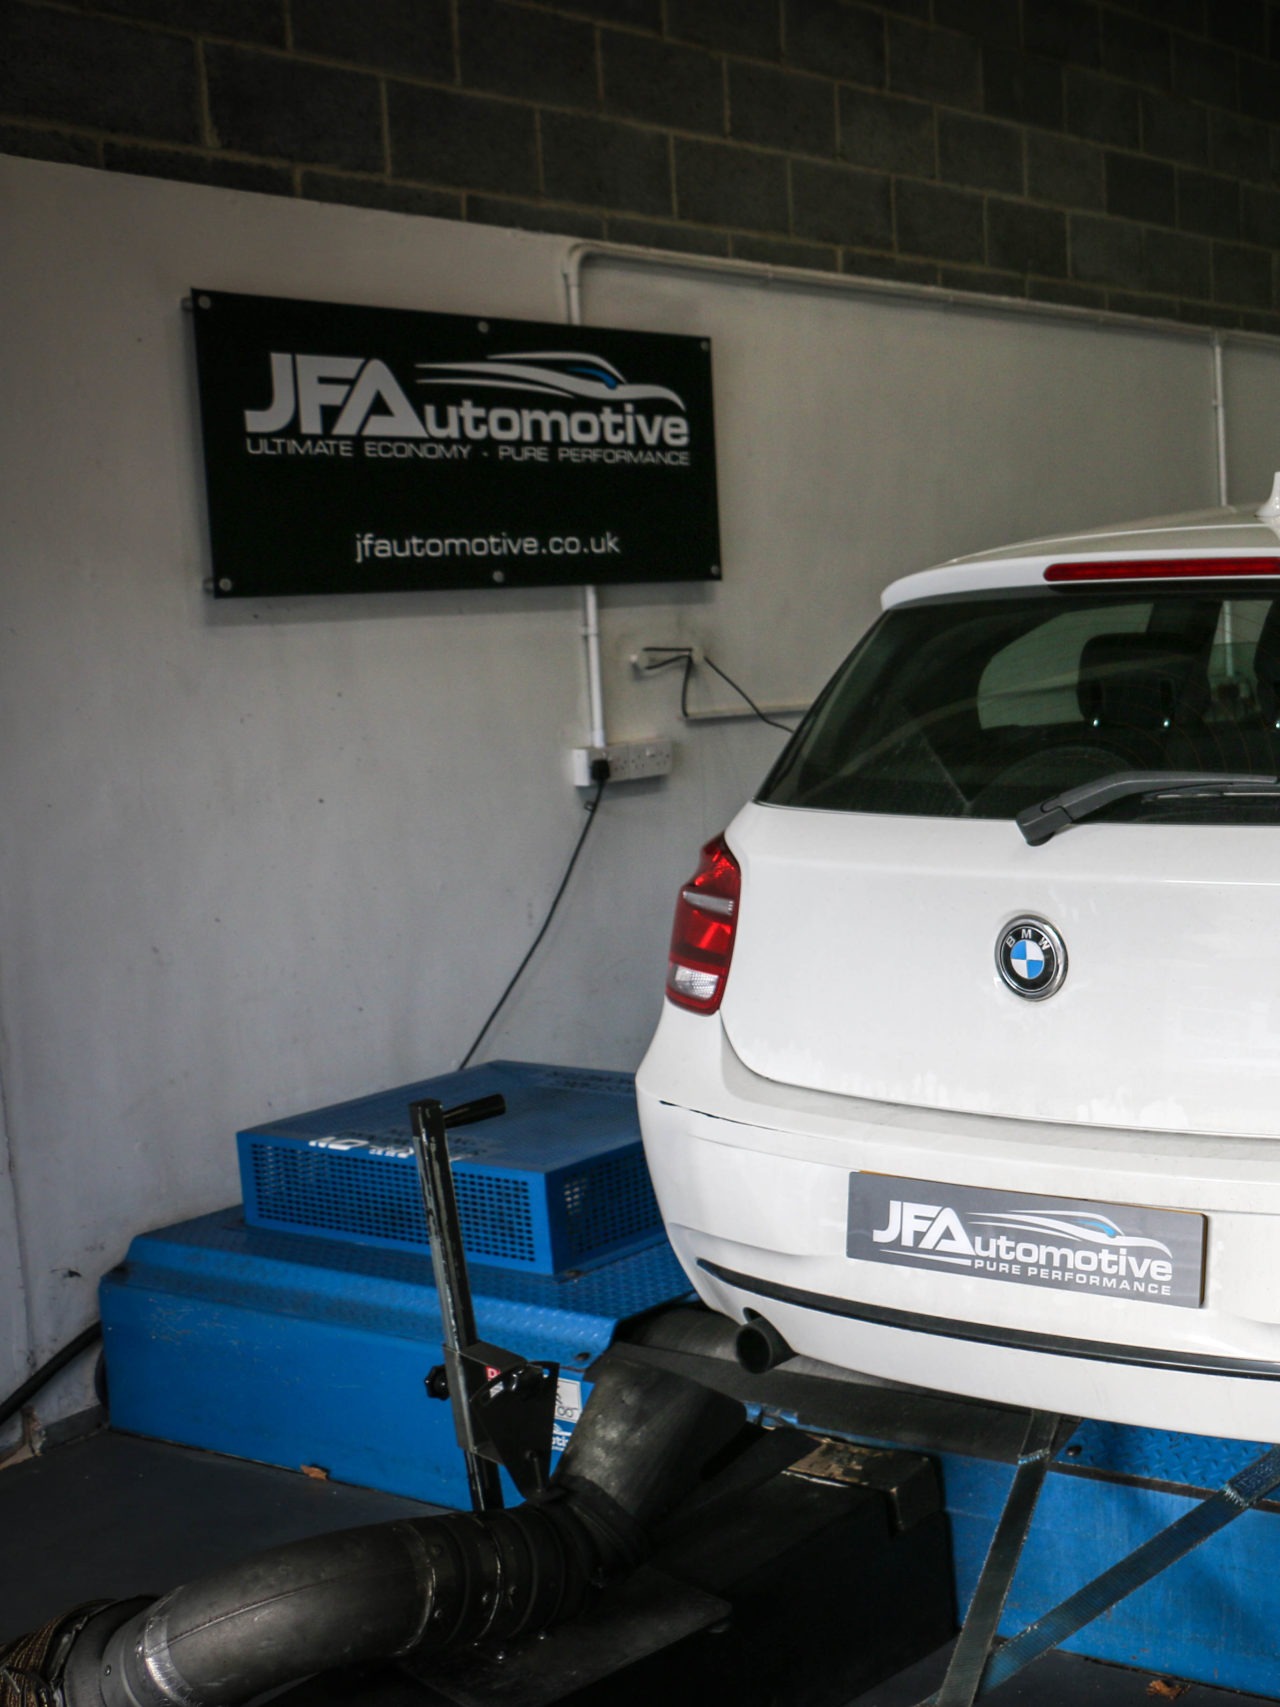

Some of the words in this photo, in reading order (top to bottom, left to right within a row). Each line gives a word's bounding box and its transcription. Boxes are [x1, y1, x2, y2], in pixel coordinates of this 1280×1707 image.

[244, 352, 690, 447] JFAutomotive
[246, 438, 353, 457] ULTIMATE
[364, 442, 471, 460] ECONOMY
[499, 446, 549, 463] PURE
[558, 447, 691, 466] PERFORMANCE
[355, 532, 620, 563] jfautomotive.co.uk
[1005, 928, 1051, 951] BMW
[872, 1200, 1173, 1282] JFAutomotive
[974, 1259, 1021, 1276] PURE
[1028, 1266, 1172, 1296] PERFORMANCE
